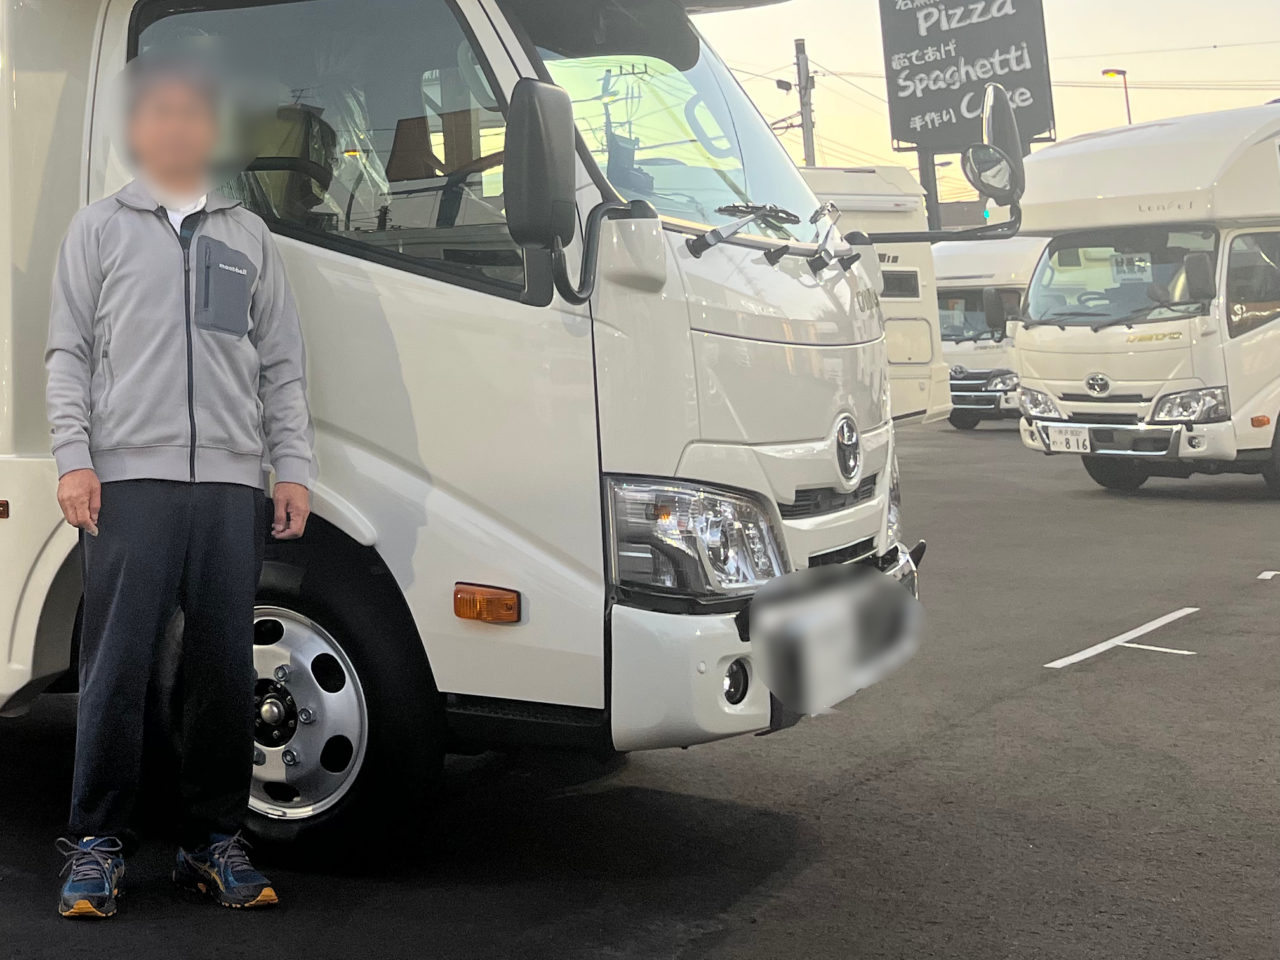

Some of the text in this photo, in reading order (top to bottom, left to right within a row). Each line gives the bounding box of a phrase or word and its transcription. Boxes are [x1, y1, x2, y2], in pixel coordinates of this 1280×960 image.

[896, 41, 1033, 98] Spaghetti
[909, 107, 957, 132] 手作り
